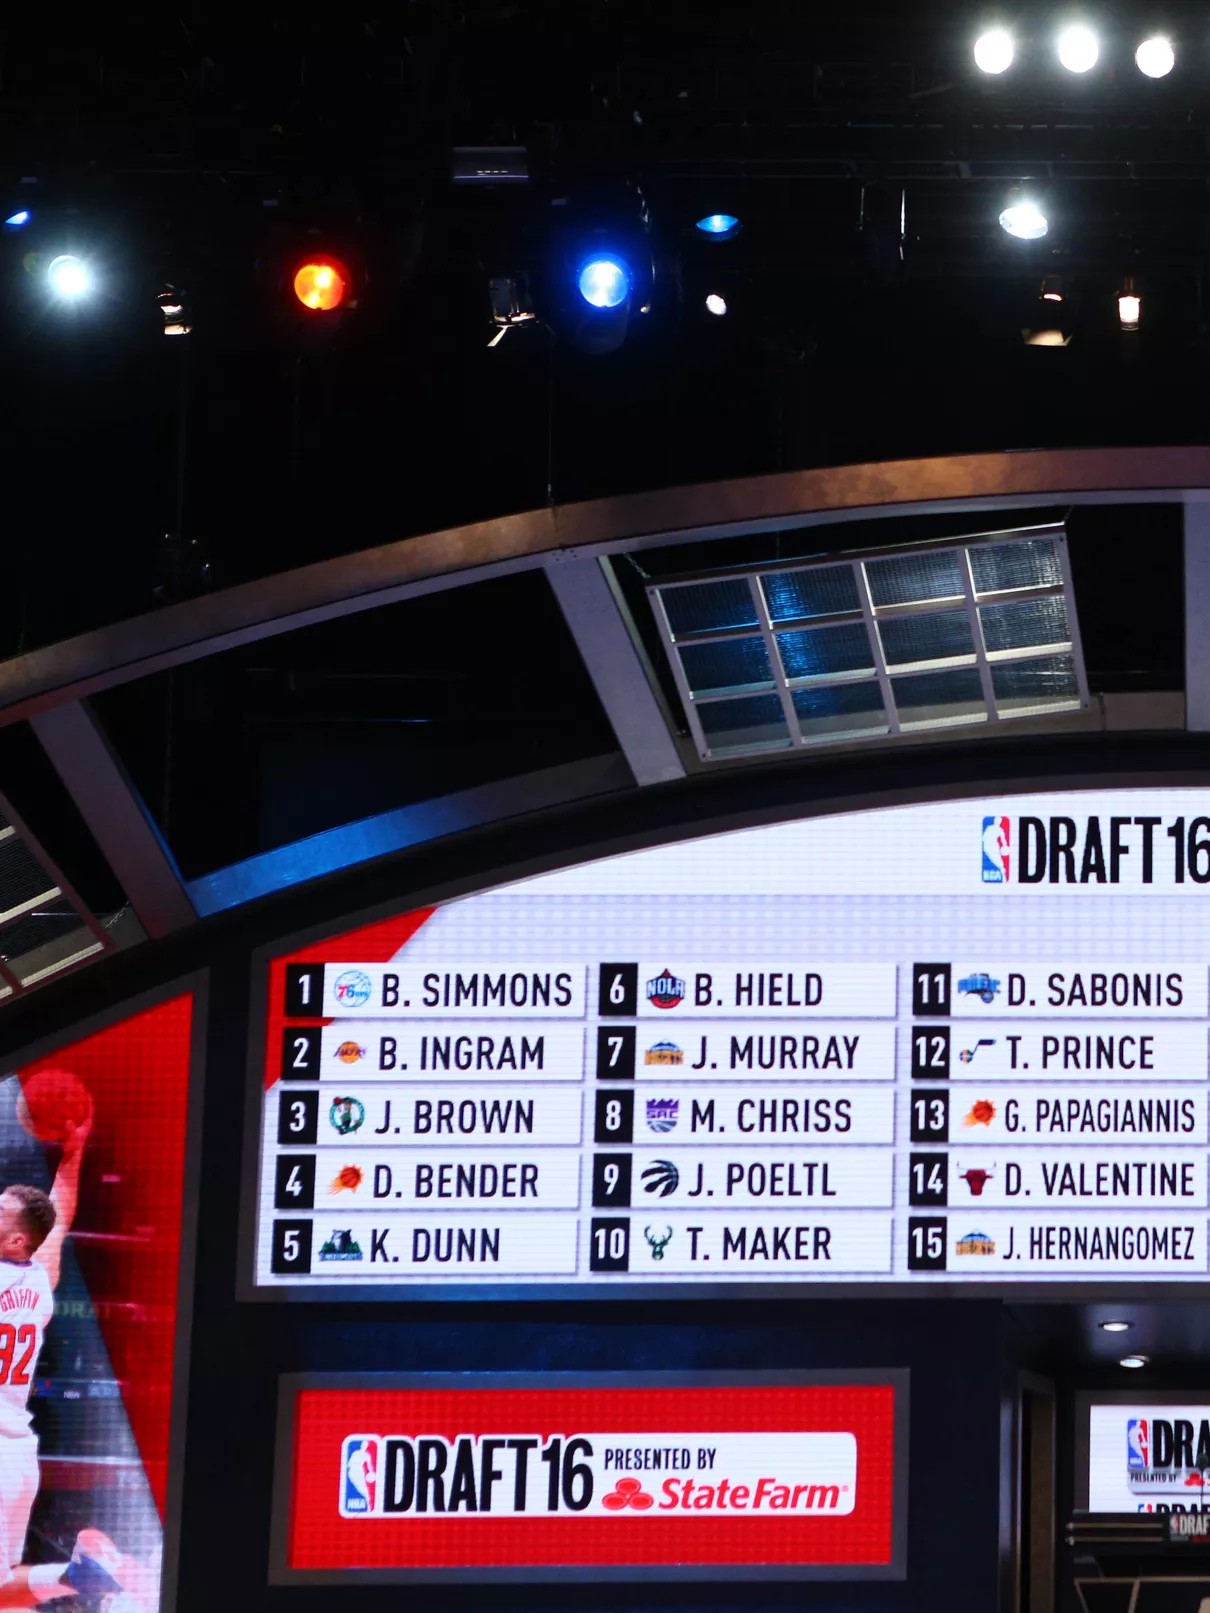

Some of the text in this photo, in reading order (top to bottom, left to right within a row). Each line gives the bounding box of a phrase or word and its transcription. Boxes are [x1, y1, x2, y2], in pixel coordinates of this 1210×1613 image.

[298, 974, 310, 1005] 1
[381, 972, 572, 1007] B. SIMMONS
[609, 973, 625, 1004] 6
[646, 980, 685, 997] NOLA
[694, 973, 823, 1007] B. HIELD
[918, 973, 945, 1004] 11
[1008, 973, 1036, 1006] D.
[1047, 972, 1183, 1007] SABONIS
[292, 1037, 309, 1068] 2
[379, 1036, 408, 1071] B.
[420, 1035, 544, 1071] INGRAM
[607, 1036, 624, 1067] 7
[691, 1035, 717, 1070] J.
[730, 1035, 860, 1070] MURRAY
[915, 1035, 1154, 1070] 12 T. PRINCE
[289, 1099, 534, 1135] 3 J. BROWN
[605, 1099, 621, 1131] 8
[691, 1098, 852, 1133] M. CHRISS
[914, 1098, 1195, 1133] 13 G. PAPAGIANNIS
[285, 1163, 539, 1199] 4 D. BENDER
[603, 1162, 837, 1197] 9 J. POELTL
[913, 1162, 1195, 1197] 14 D. VALENTINE
[283, 1228, 500, 1263] 5 K. DUNN
[594, 1226, 831, 1261] 10 T. MAKER
[912, 1226, 943, 1259] 15
[1002, 1226, 1021, 1260] J.
[1029, 1226, 1195, 1260] HERNANGOMEZ
[604, 1448, 717, 1470] PRESENTED BY
